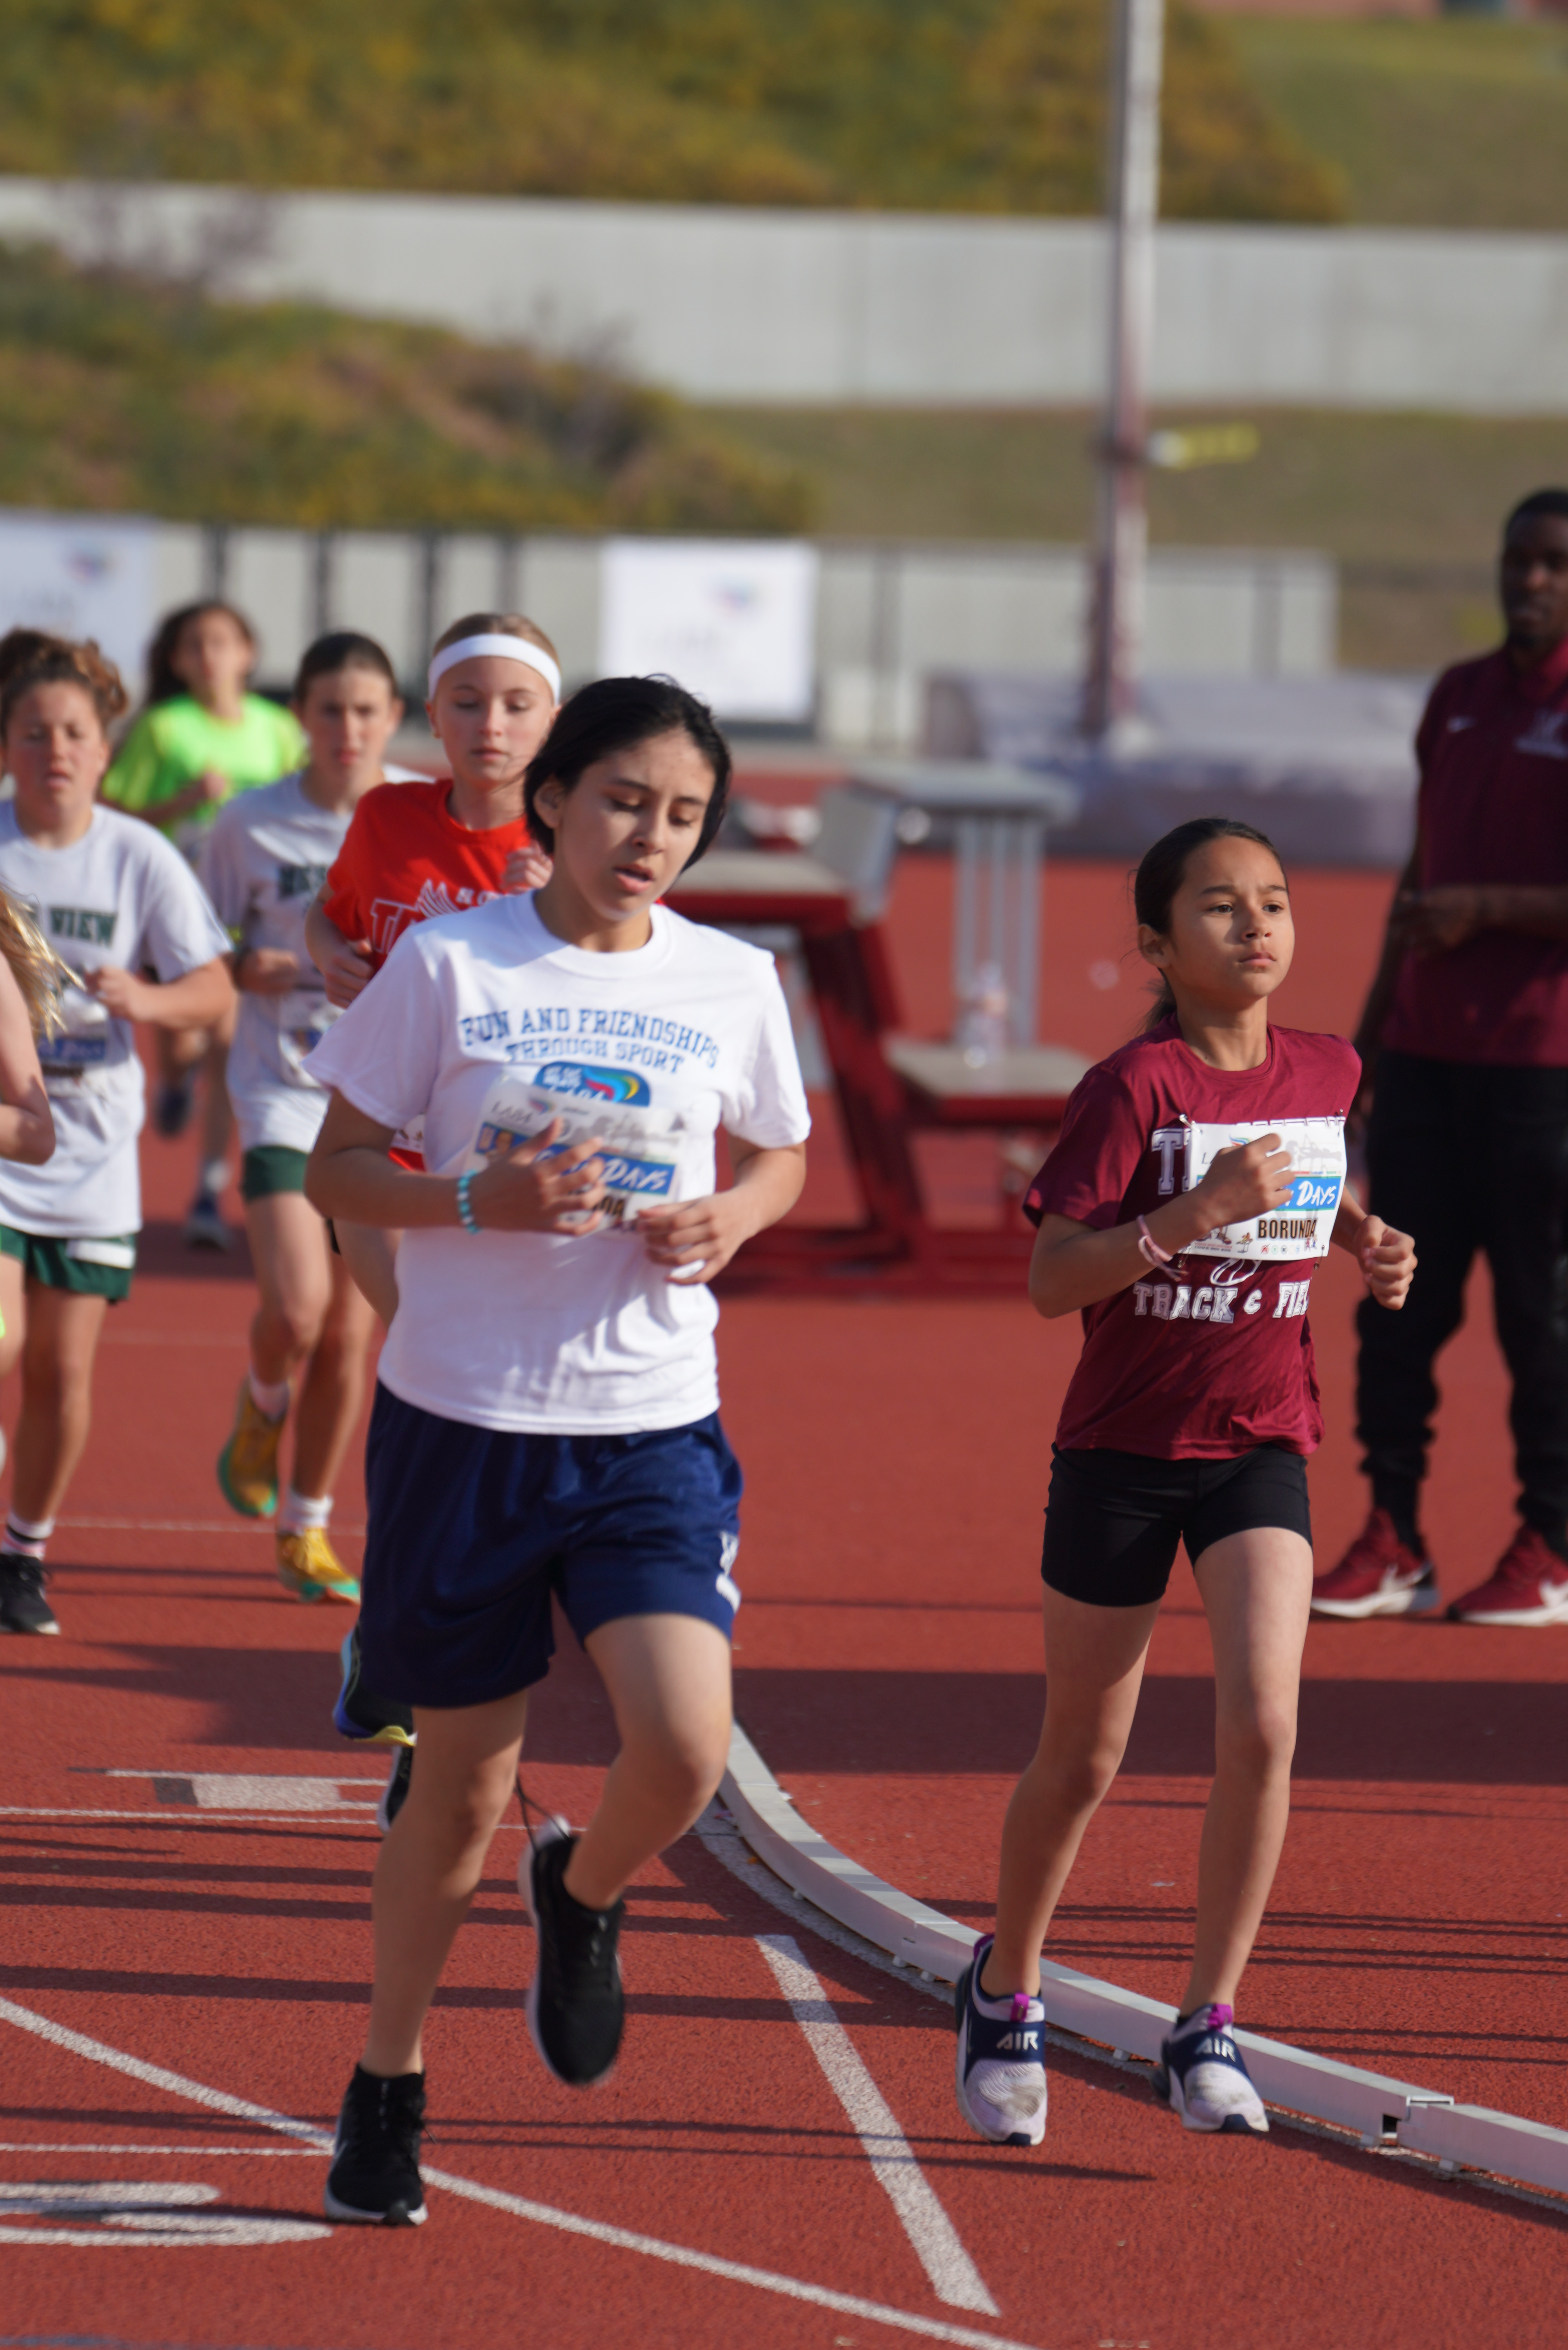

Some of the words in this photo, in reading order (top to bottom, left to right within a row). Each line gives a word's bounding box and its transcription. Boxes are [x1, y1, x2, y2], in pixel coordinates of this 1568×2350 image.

[50, 908, 117, 948] VIEW
[458, 1010, 509, 1046] FUN
[520, 1008, 569, 1034] AND
[577, 1008, 720, 1069] FRIENDSHIPS
[505, 1038, 608, 1062] THROUGH
[615, 1042, 685, 1074] SPORT
[1258, 1219, 1318, 1239] BORUNDA
[1133, 1281, 1238, 1324] TRACK
[996, 2031, 1039, 2051] AIR
[1194, 2037, 1236, 2062] AIR
